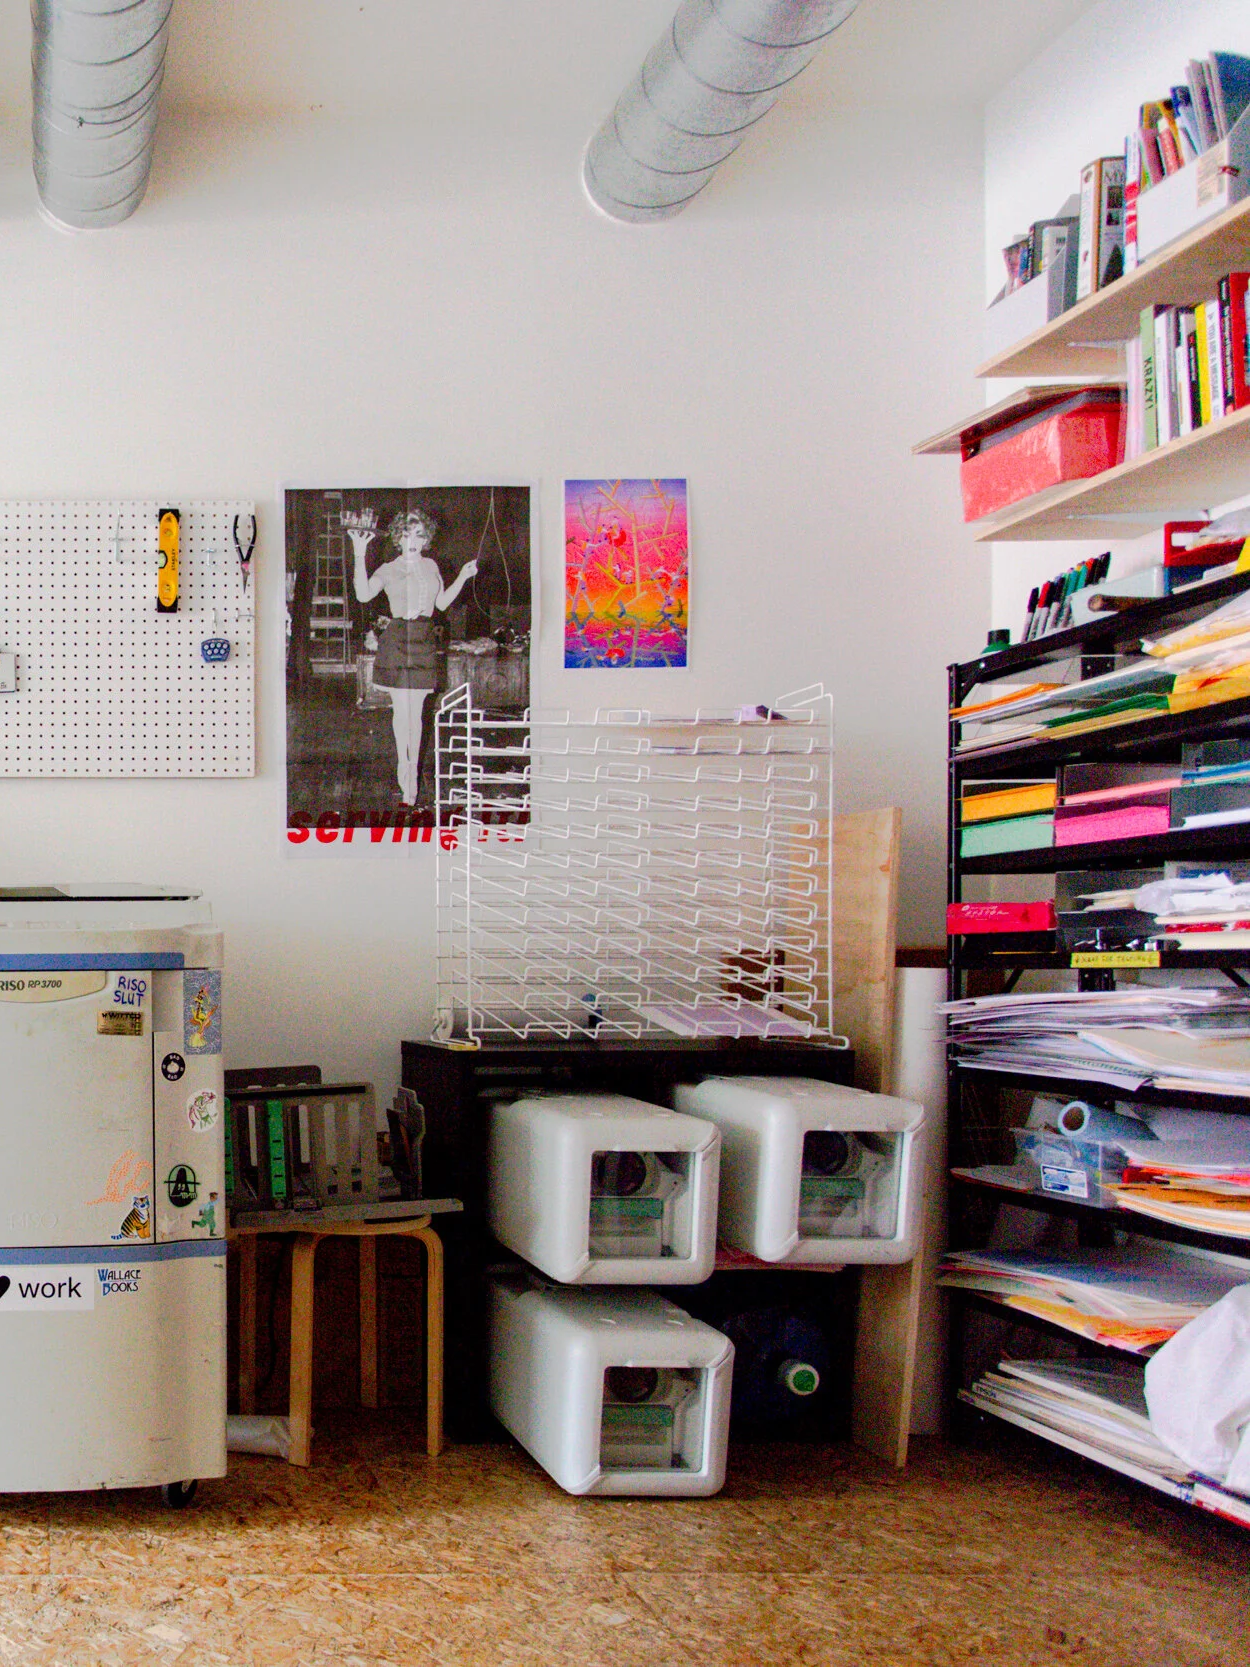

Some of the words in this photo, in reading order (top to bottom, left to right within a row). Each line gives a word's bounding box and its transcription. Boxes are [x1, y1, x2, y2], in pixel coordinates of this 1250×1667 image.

[1143, 356, 1154, 410] KRAZY!
[287, 802, 464, 851] serving
[118, 976, 146, 993] RISO
[113, 990, 144, 1007] SLUT
[97, 1269, 142, 1282] WALLACE
[18, 1277, 82, 1298] work
[102, 1281, 139, 1297] BOOKS
